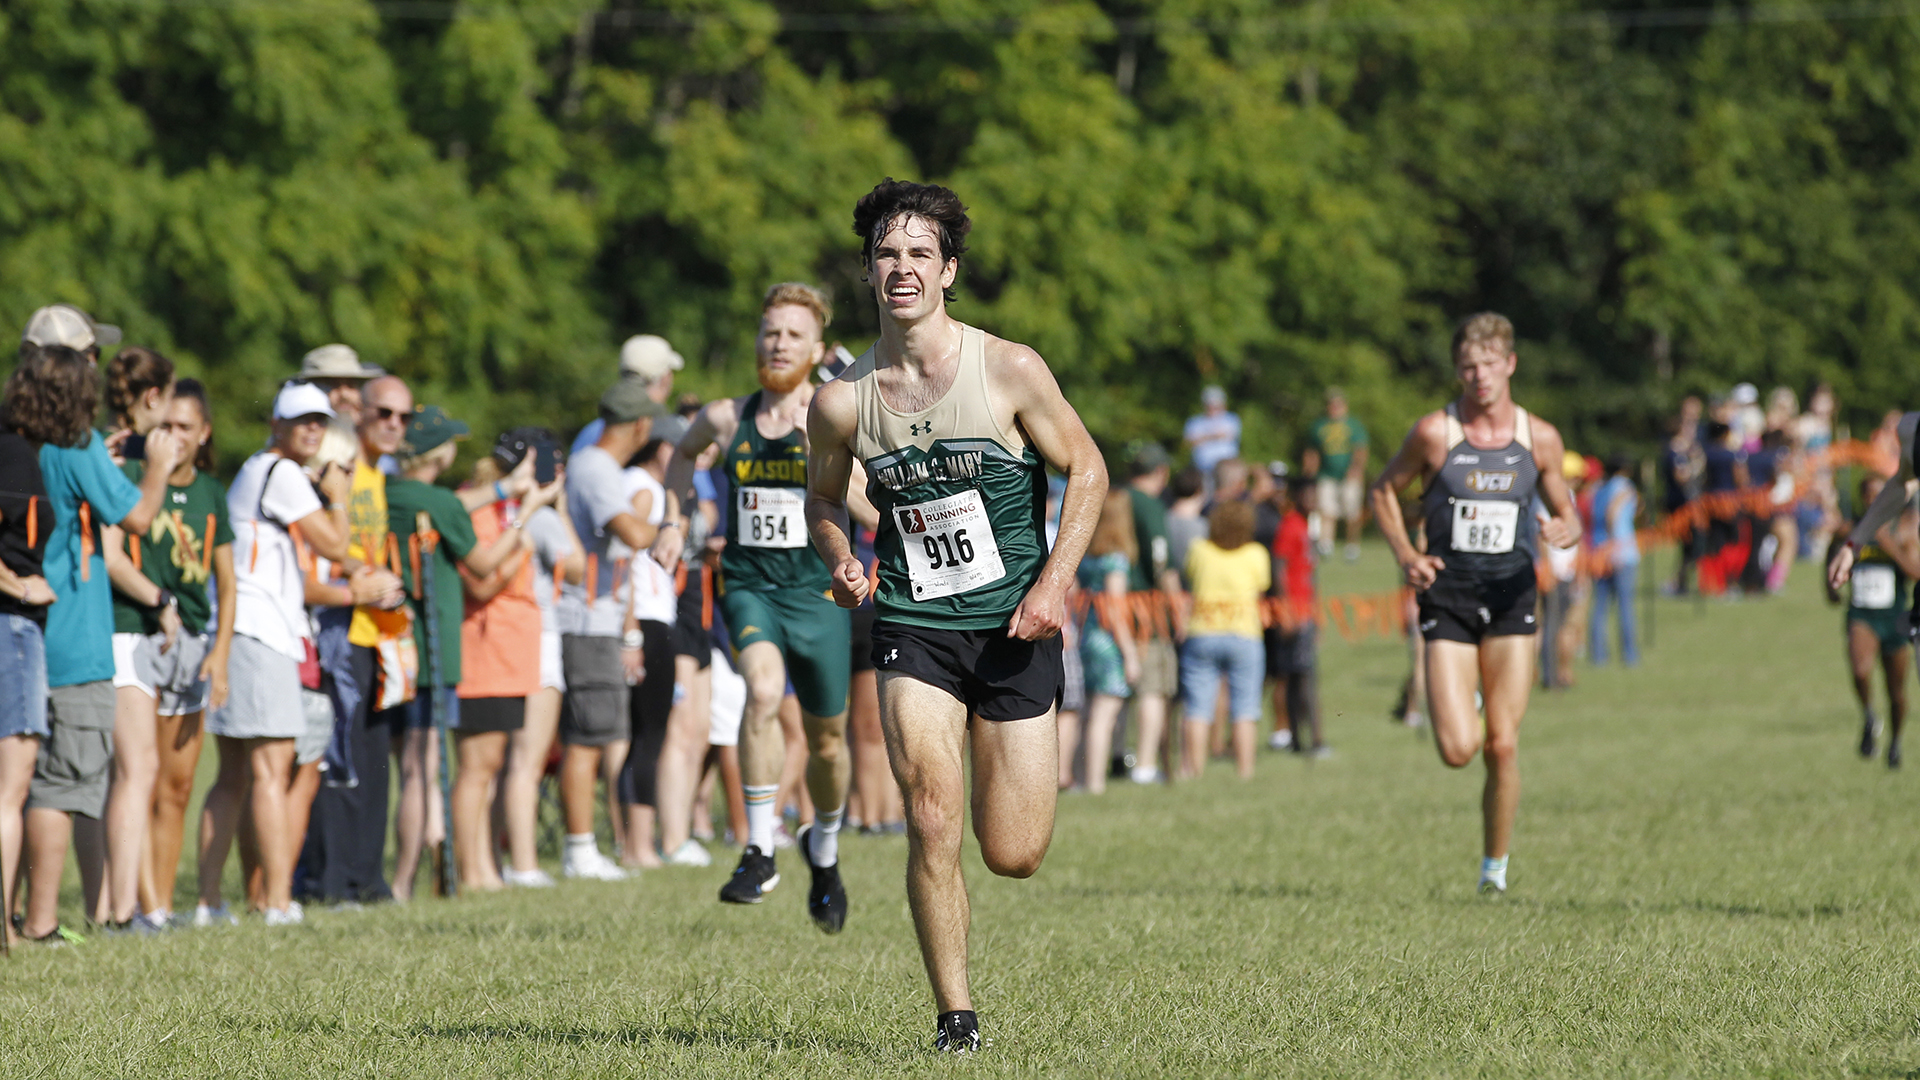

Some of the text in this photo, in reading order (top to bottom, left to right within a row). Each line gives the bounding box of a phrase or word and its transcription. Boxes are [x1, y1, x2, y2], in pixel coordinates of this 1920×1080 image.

[735, 459, 806, 485] MASON
[876, 459, 930, 491] WILLIAM
[945, 450, 982, 481] MARY
[1475, 470, 1516, 492] VCU
[923, 496, 974, 514] COLLEGIATE
[925, 503, 976, 523] RUNNING
[752, 514, 788, 541] 854
[929, 514, 980, 531] ASSOCIATION
[1468, 525, 1503, 548] 882
[922, 528, 975, 570] 916
